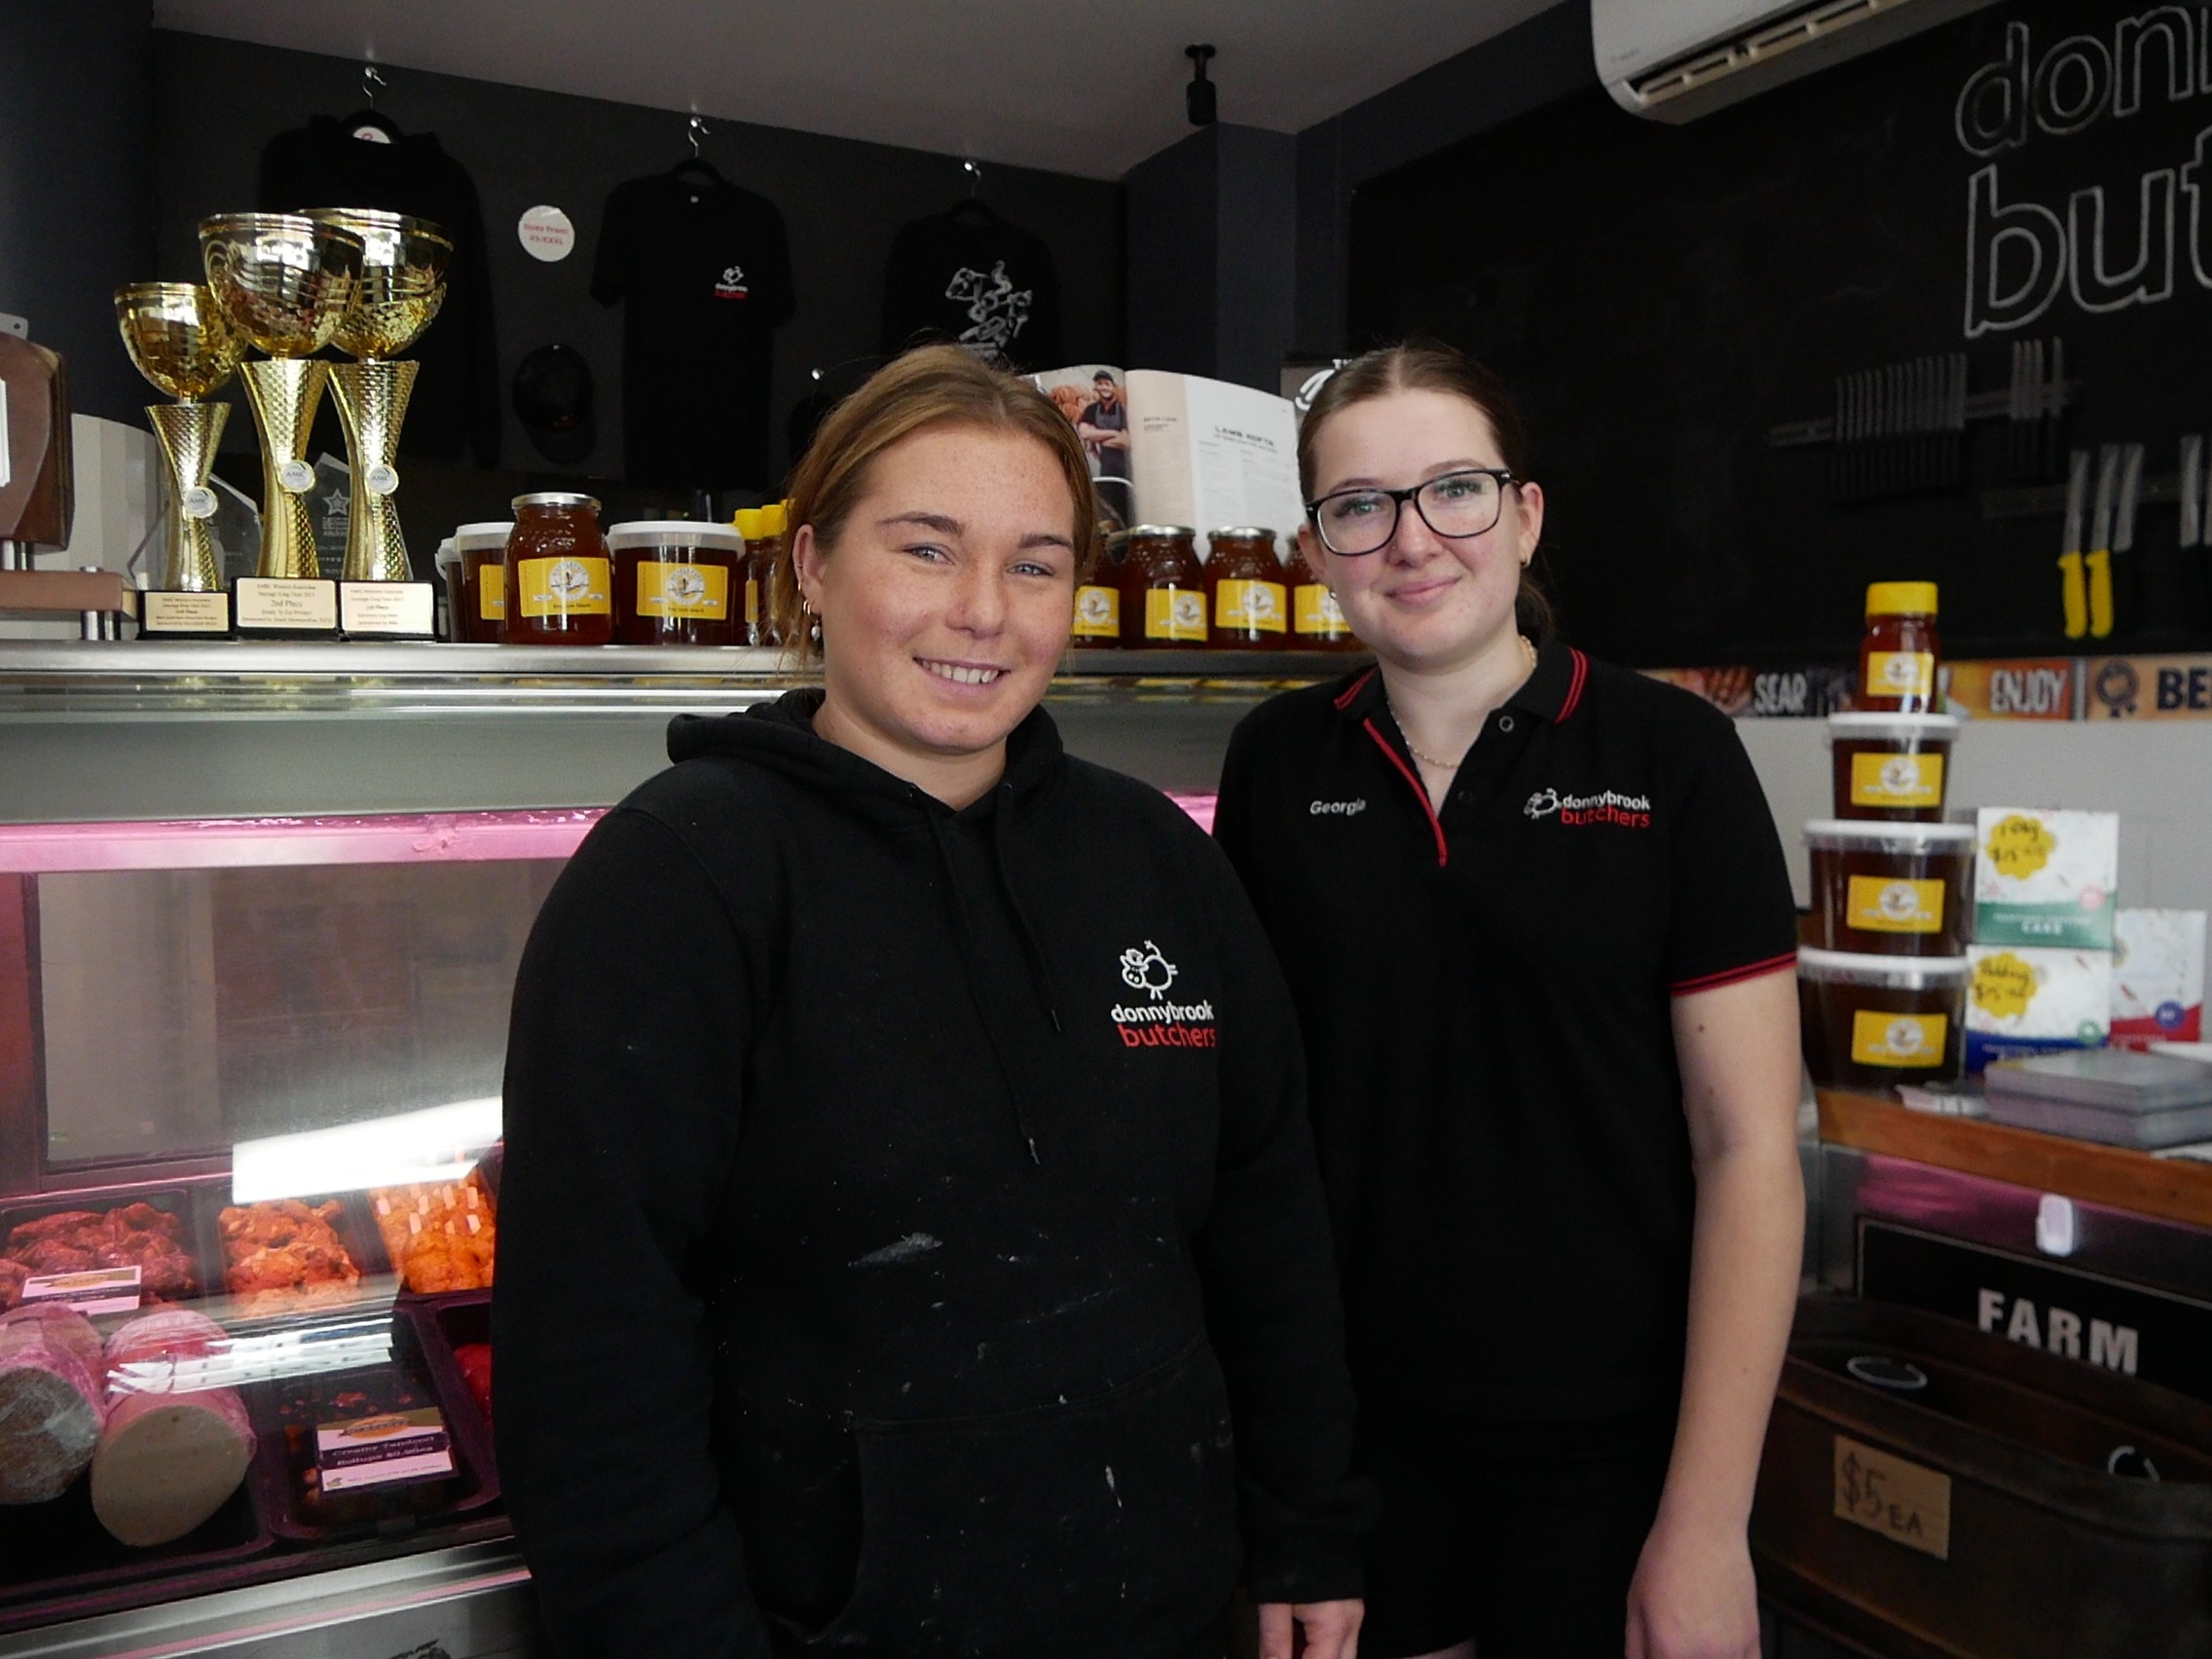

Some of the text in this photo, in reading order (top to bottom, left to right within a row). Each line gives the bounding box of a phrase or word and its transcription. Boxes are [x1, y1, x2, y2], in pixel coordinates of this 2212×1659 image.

[1955, 5, 2212, 158] don
[1753, 672, 1808, 714] SEAR
[1989, 668, 2068, 714] ENJOY
[2156, 666, 2212, 711] BE
[1561, 804, 1651, 828] butchers
[1563, 789, 1651, 810] donnybrook
[1110, 999, 1215, 1024] donnybrook
[1117, 1020, 1216, 1048] butchers
[1977, 1286, 2139, 1378] FARM
